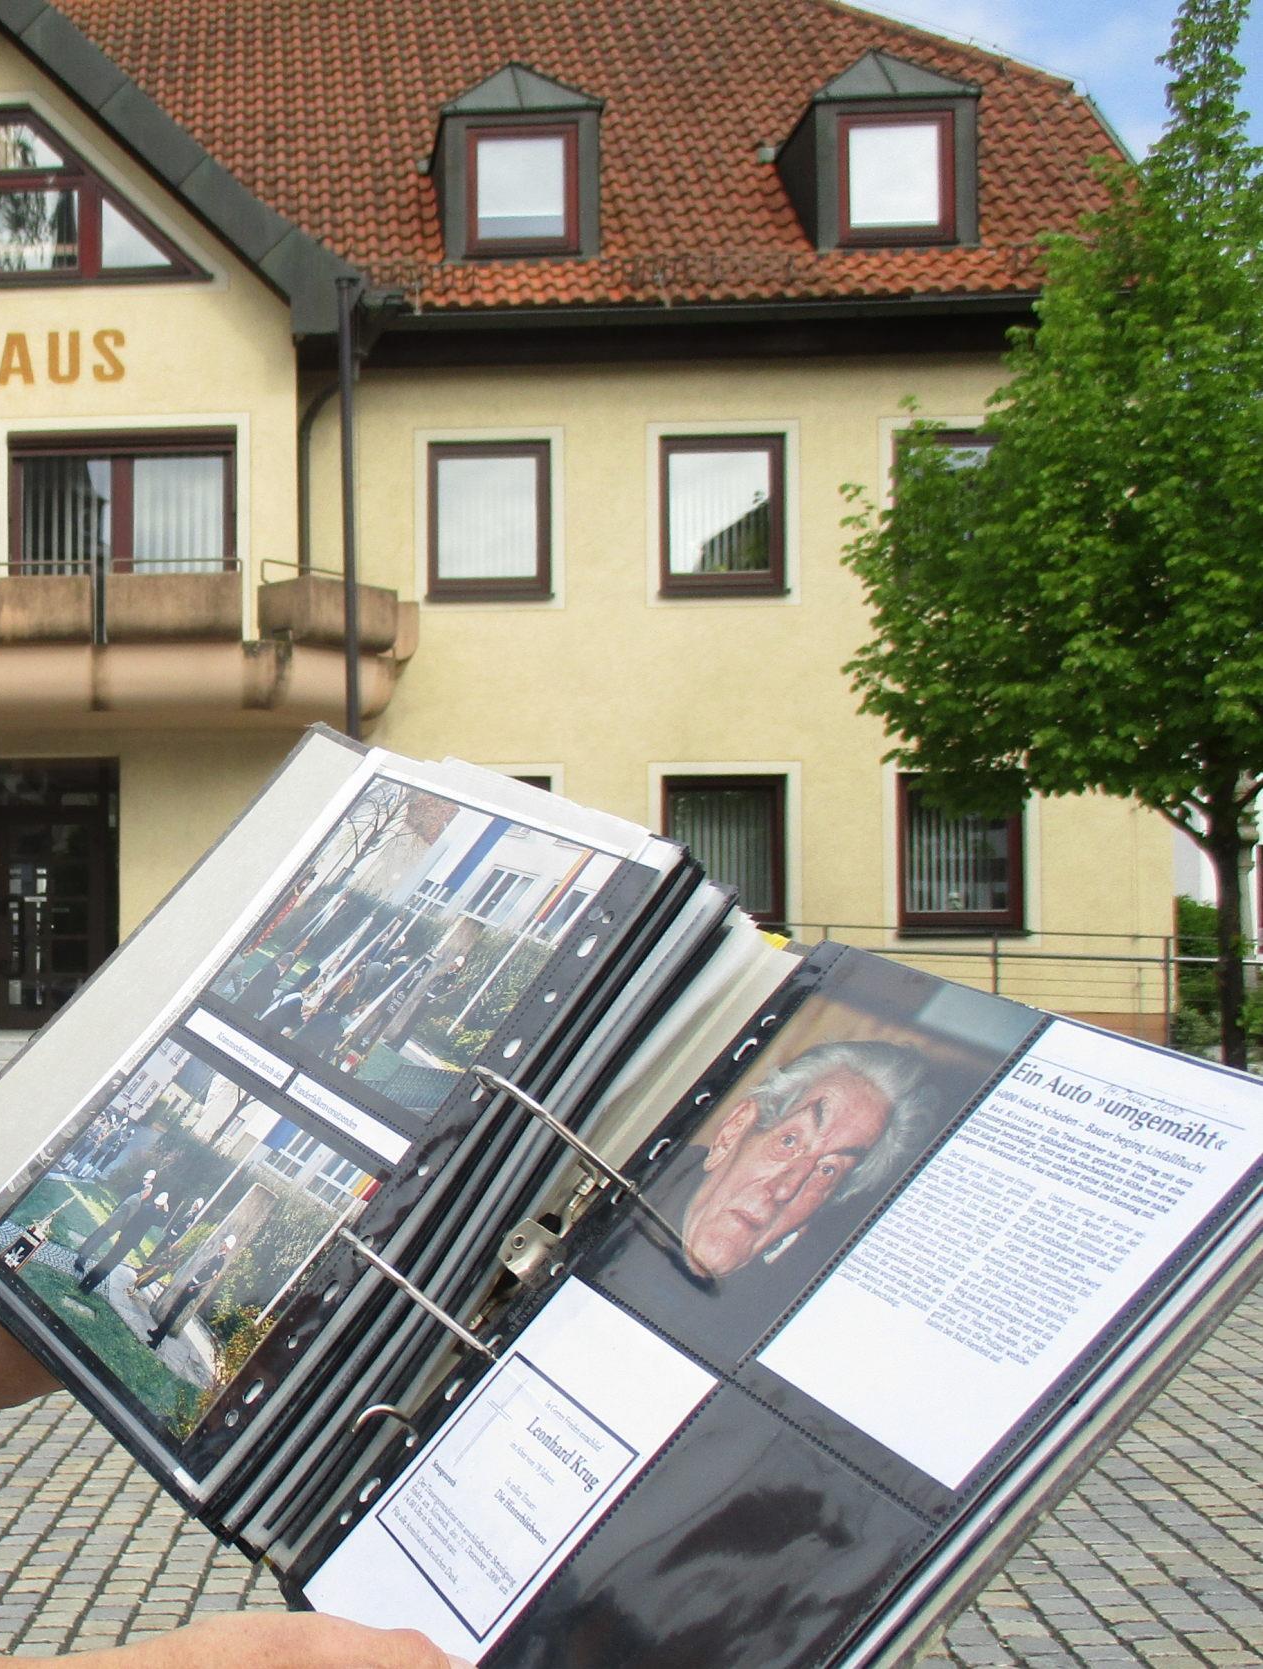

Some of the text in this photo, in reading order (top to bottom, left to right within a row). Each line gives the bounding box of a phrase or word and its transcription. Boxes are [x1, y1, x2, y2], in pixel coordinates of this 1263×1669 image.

[997, 1090, 1018, 1102] 6000
[1019, 1097, 1040, 1111] Mark
[1040, 1105, 1078, 1125] Schaden
[1084, 1122, 1113, 1138] Bauer
[1112, 1132, 1146, 1153] beging
[1145, 1145, 1206, 1173] Unfallflucht
[1011, 1062, 1229, 1150] Ein Auto »umgemäht«
[526, 1416, 599, 1493] Leonhard Krug
[493, 1488, 546, 1544] Die Hinterbliebenen
